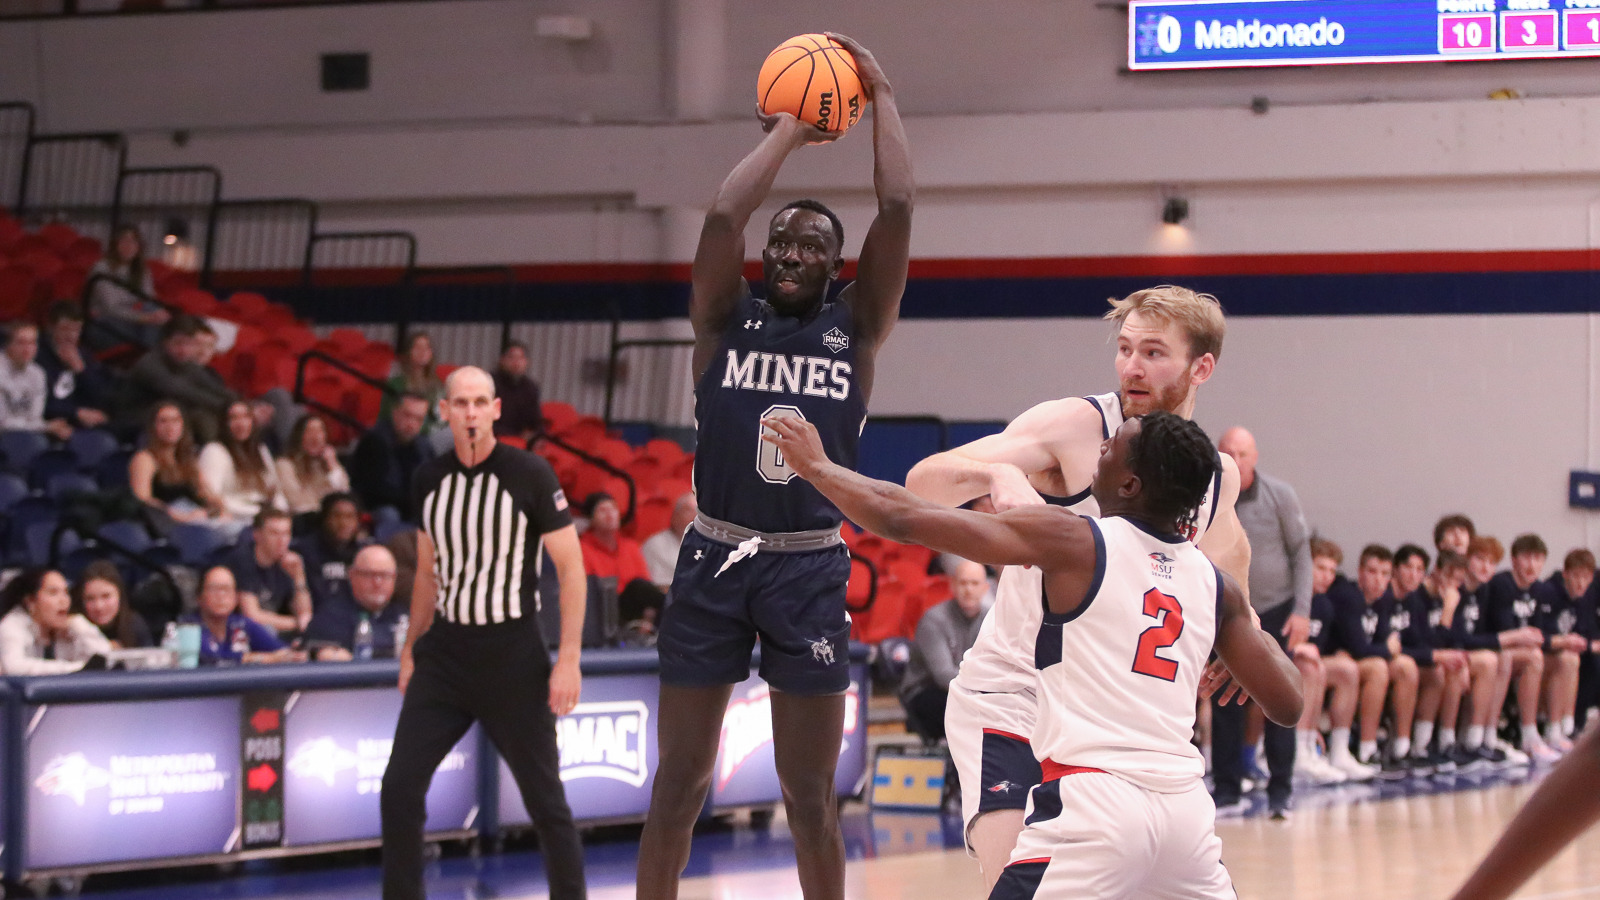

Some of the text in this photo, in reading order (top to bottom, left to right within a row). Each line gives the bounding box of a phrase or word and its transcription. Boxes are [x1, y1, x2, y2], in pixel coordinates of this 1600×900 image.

[1194, 16, 1345, 50] Maldonado
[1452, 21, 1482, 48] 10
[1521, 19, 1538, 45] 3
[813, 90, 833, 132] son
[825, 335, 848, 347] RMAC
[721, 348, 853, 402] MINES
[1151, 562, 1173, 575] MSU
[1131, 586, 1185, 683] 2
